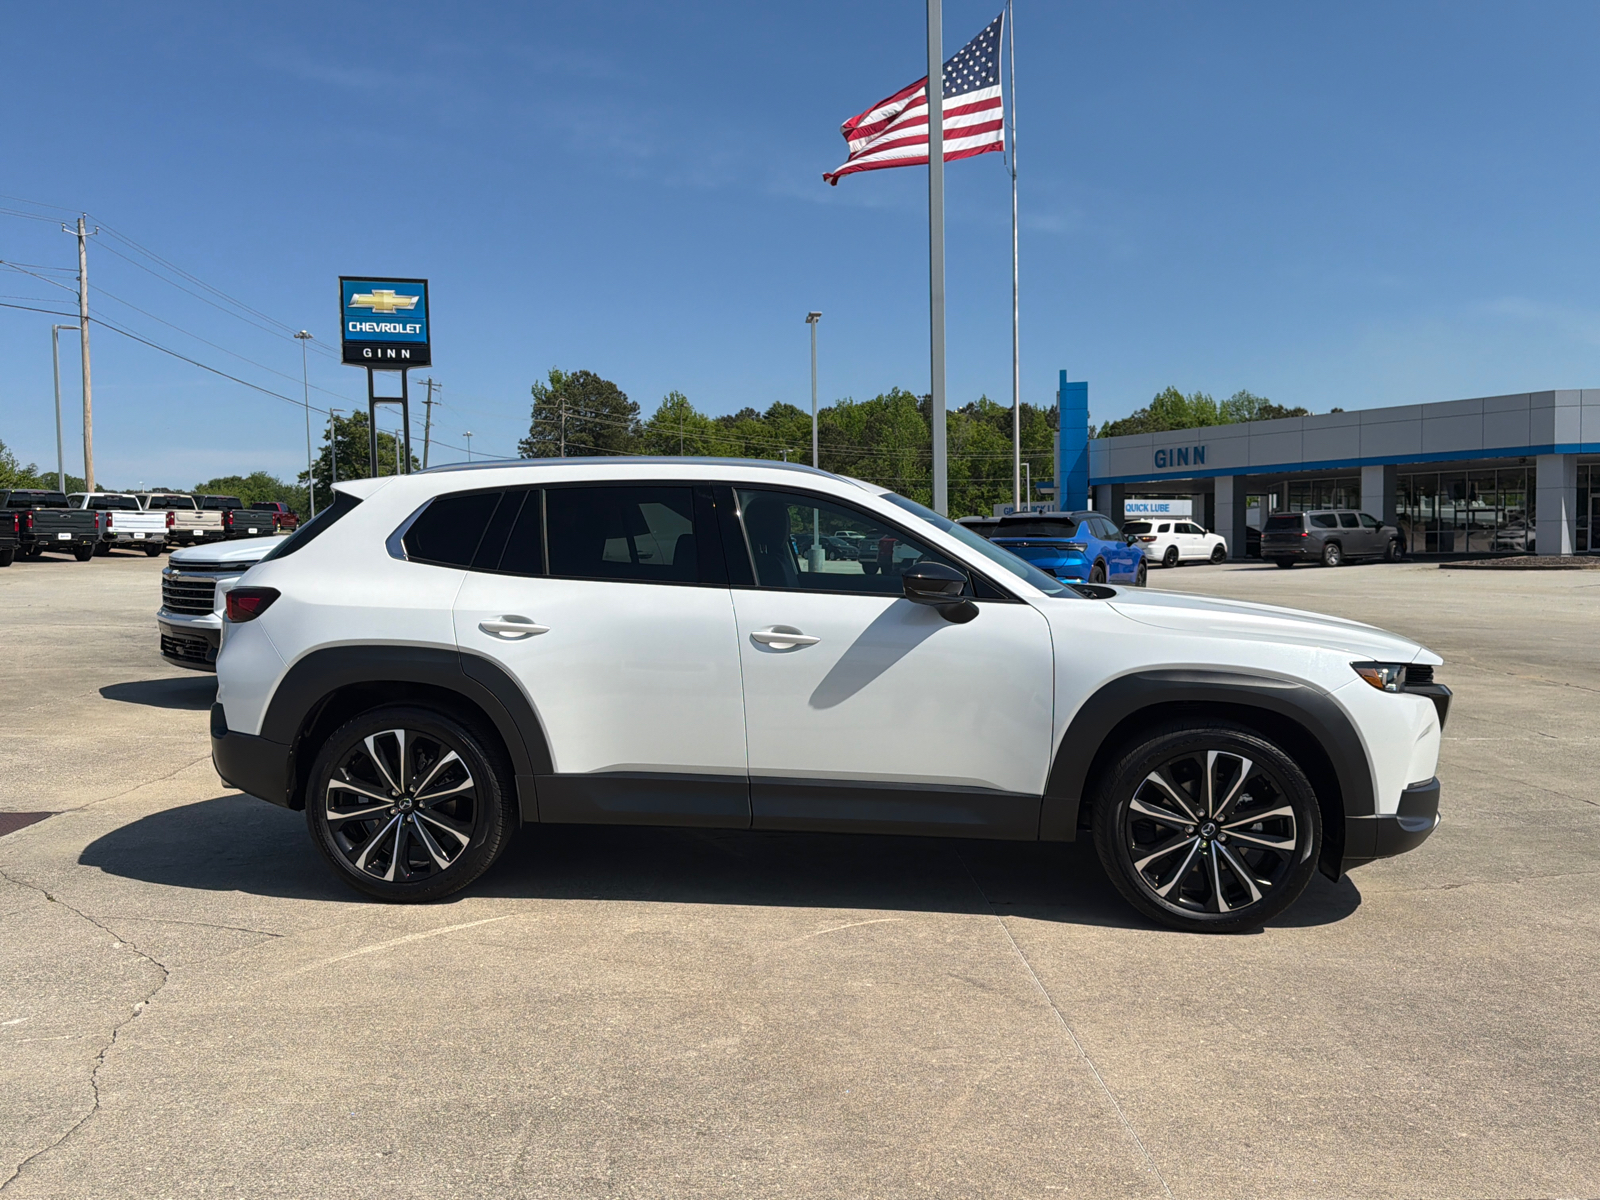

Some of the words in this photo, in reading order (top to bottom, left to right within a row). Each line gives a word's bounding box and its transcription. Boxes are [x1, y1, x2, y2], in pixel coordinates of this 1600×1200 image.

[348, 321, 422, 334] CHEVROLET
[363, 348, 411, 359] GINN
[1154, 445, 1205, 469] GINN
[1125, 503, 1149, 513] QUICK
[1150, 503, 1170, 513] LUBE
